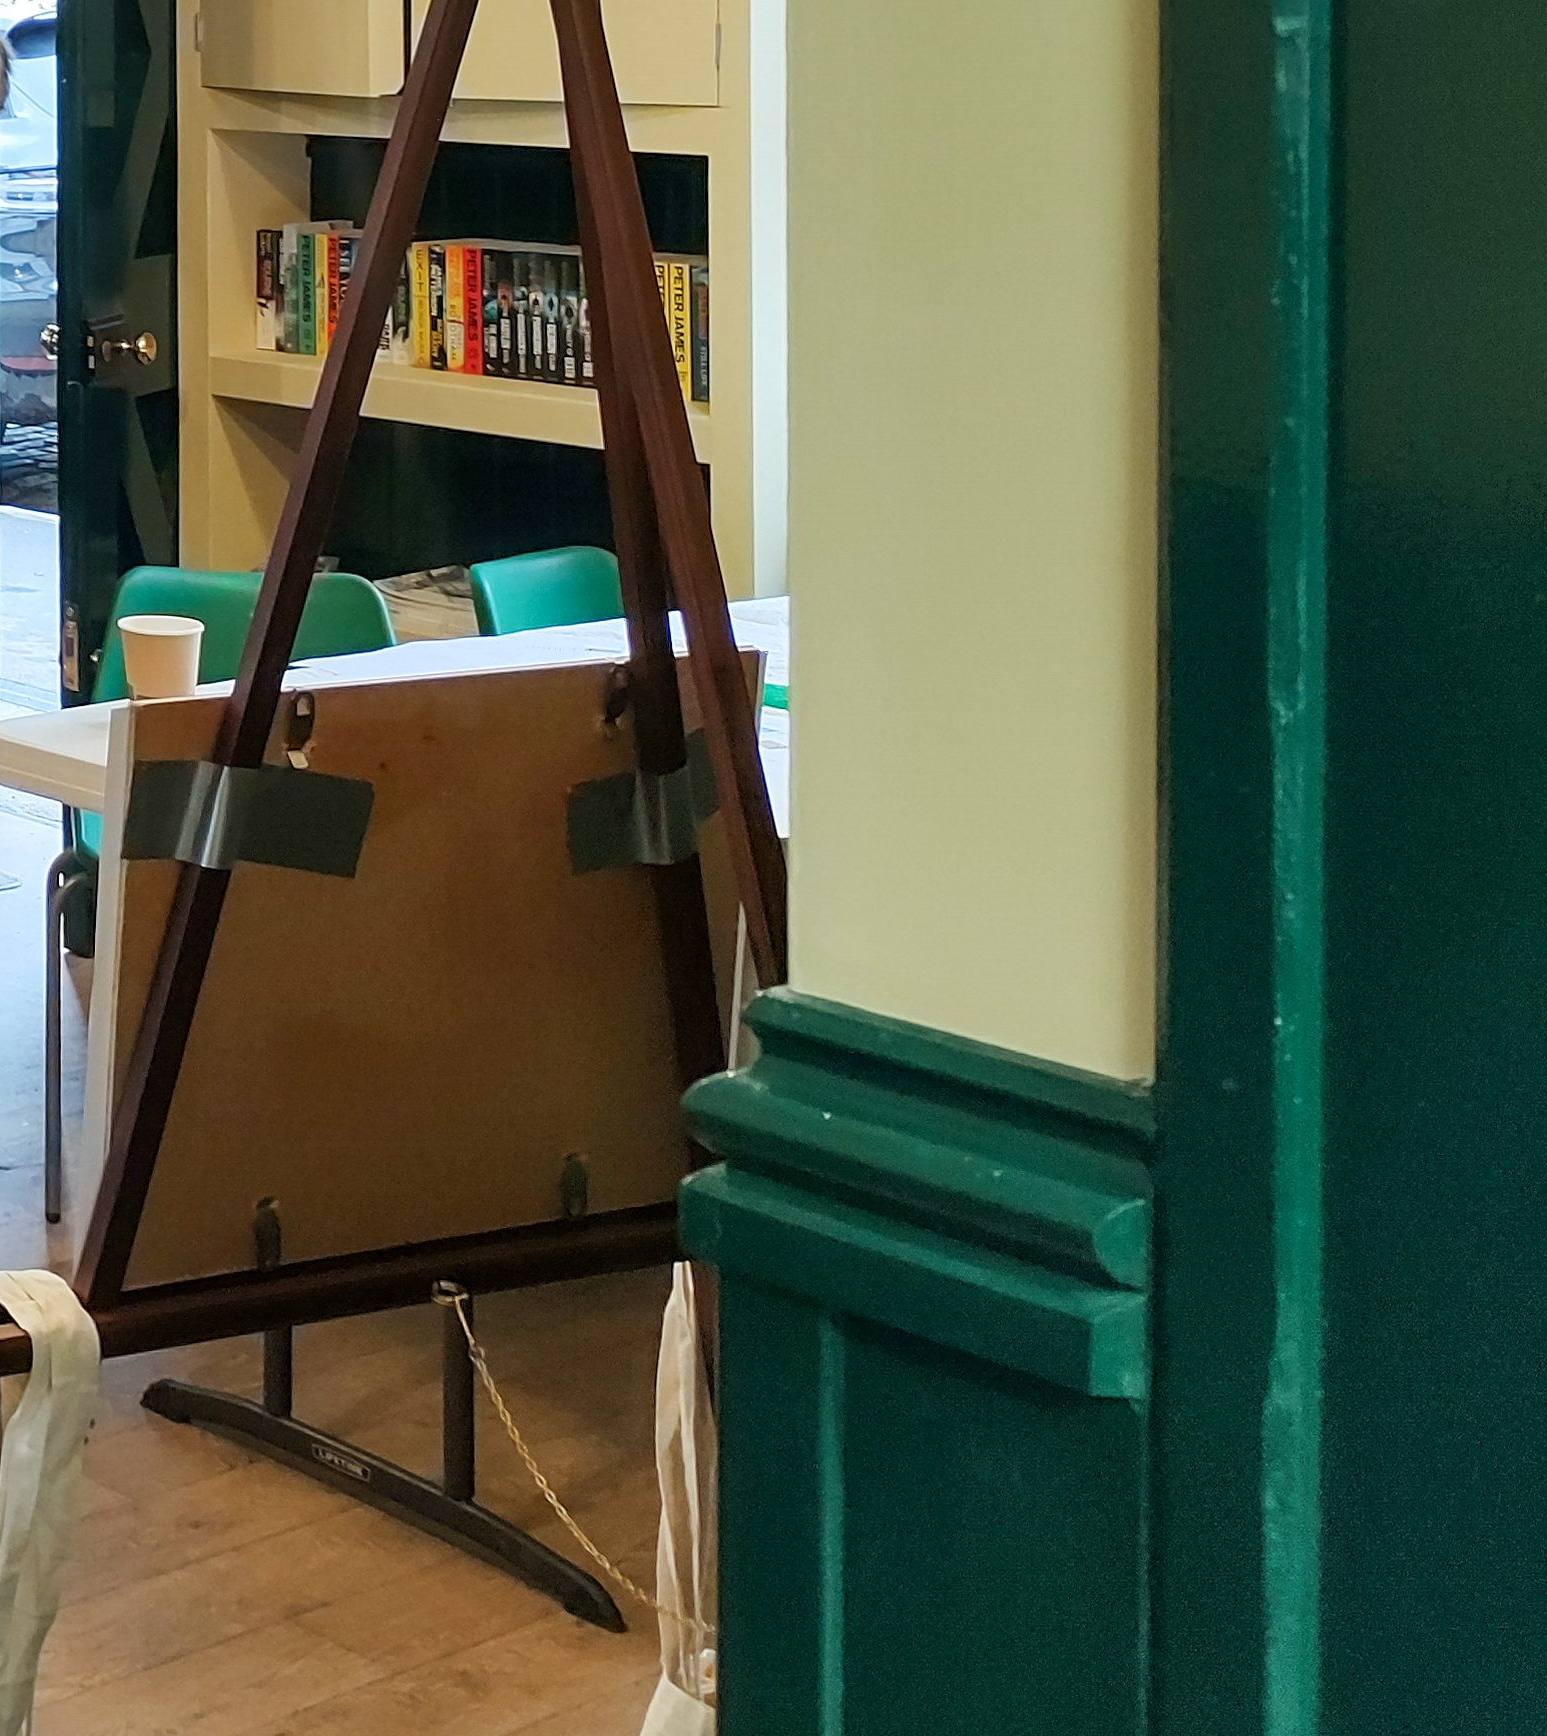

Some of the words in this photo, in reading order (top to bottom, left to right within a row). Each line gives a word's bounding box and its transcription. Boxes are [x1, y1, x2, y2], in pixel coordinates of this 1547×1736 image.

[301, 234, 310, 277] PETER
[328, 237, 337, 277] PETER
[415, 249, 424, 292] EXIT
[467, 249, 477, 293] PETER
[302, 281, 312, 323] JAMES
[329, 282, 338, 324] JAMES
[673, 265, 684, 312] PETER
[468, 297, 478, 341] JAMES
[674, 316, 685, 363] JAMES
